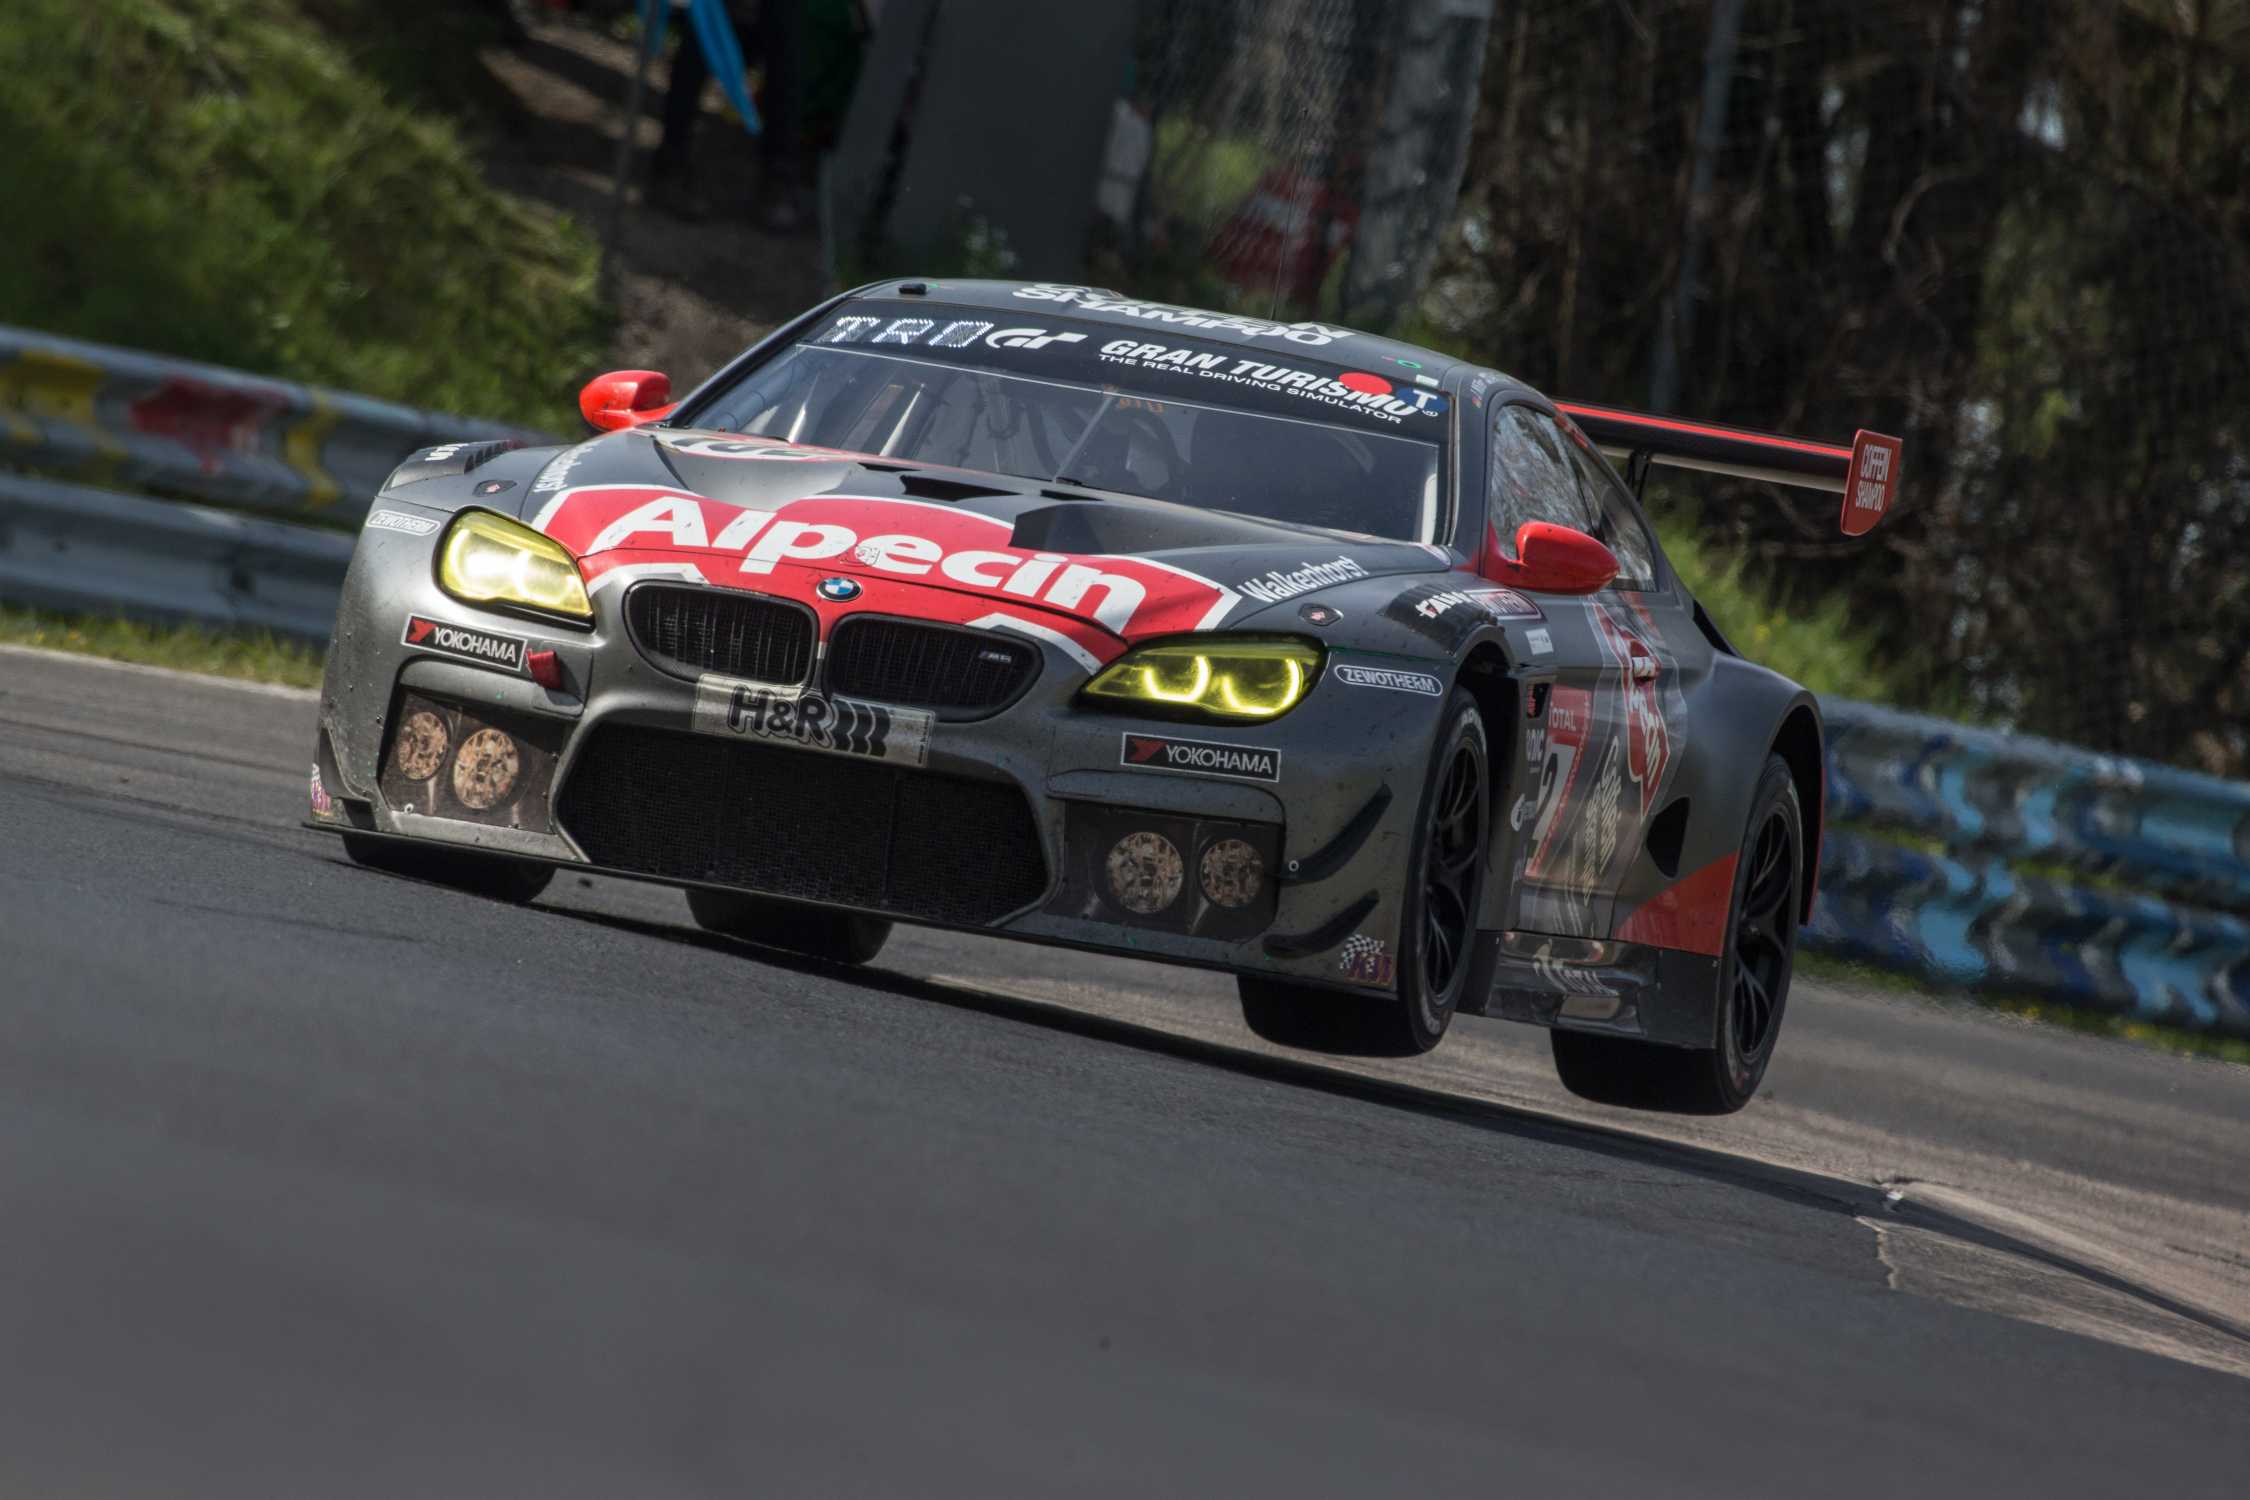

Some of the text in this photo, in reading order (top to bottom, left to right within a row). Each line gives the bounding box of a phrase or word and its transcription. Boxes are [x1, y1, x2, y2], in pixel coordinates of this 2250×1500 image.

[1100, 340, 1228, 370] GRAN
[1098, 354, 1402, 424] THE REAL DRIVING SIMULATOR
[587, 496, 1147, 636] Alpecin
[1238, 555, 1368, 603] Walkenhorst
[434, 626, 516, 663] YOKOHAMA
[1344, 668, 1437, 693] ZEWOTHERM
[727, 684, 836, 749] H&R
[1165, 744, 1273, 774] YOKOHAMA
